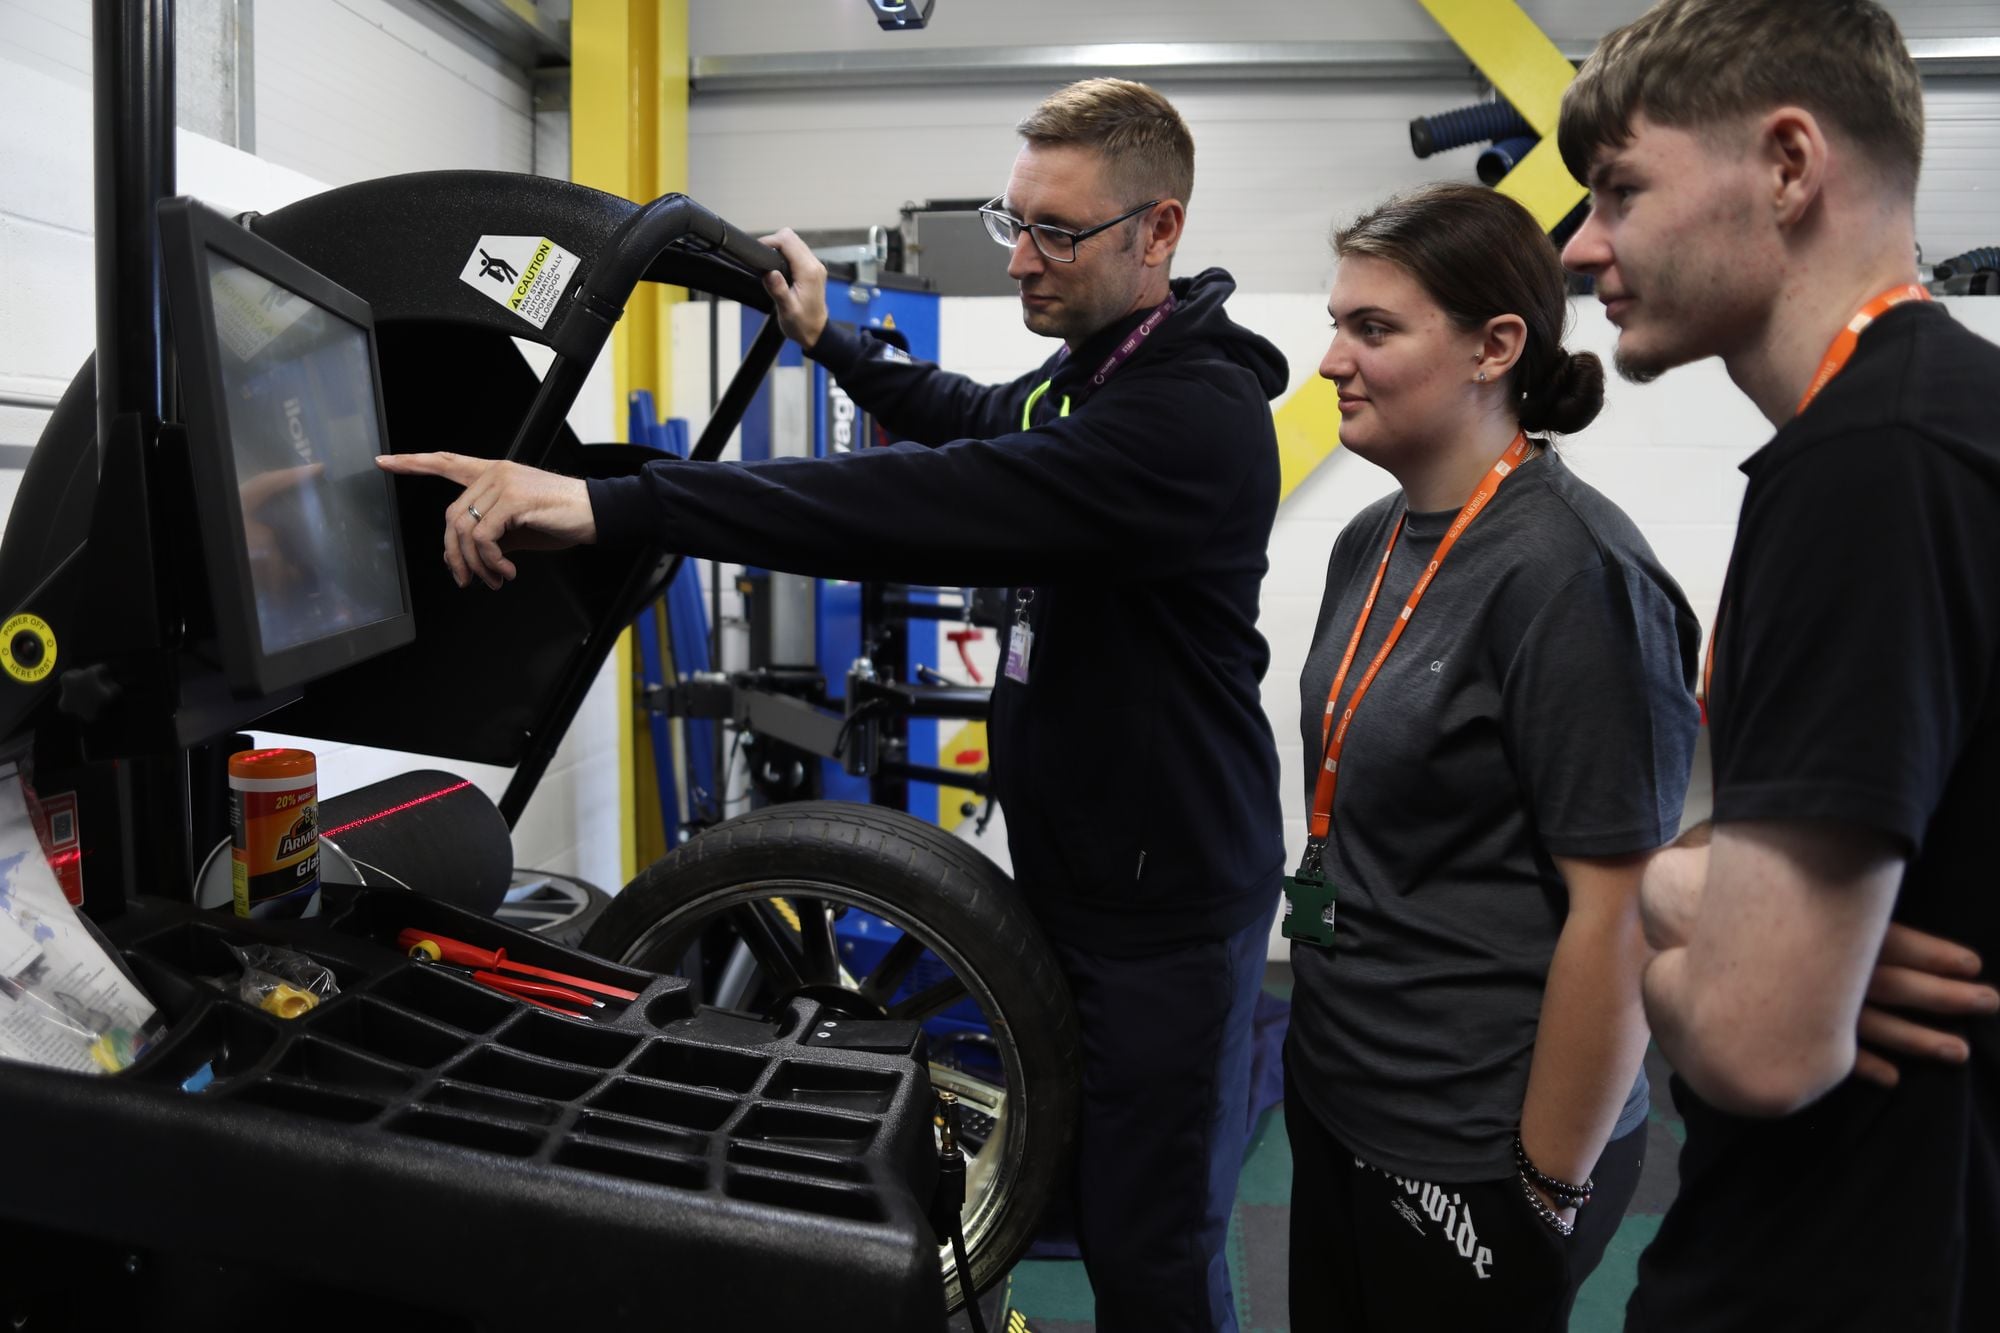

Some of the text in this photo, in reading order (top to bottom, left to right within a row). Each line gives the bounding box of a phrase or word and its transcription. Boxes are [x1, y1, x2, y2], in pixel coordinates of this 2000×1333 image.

[517, 244, 551, 296] CAUTION
[526, 253, 563, 316] AUTOMATICALLY
[520, 270, 547, 312] MAY START
[532, 273, 561, 320] UPON HOOD
[538, 289, 560, 323] CLOSING
[1122, 339, 1136, 353] STAFF
[1466, 490, 1487, 515] STUDENT
[3, 616, 46, 637] POWER OFF
[10, 657, 53, 679] HERE FIRST
[275, 794, 296, 810] 20%
